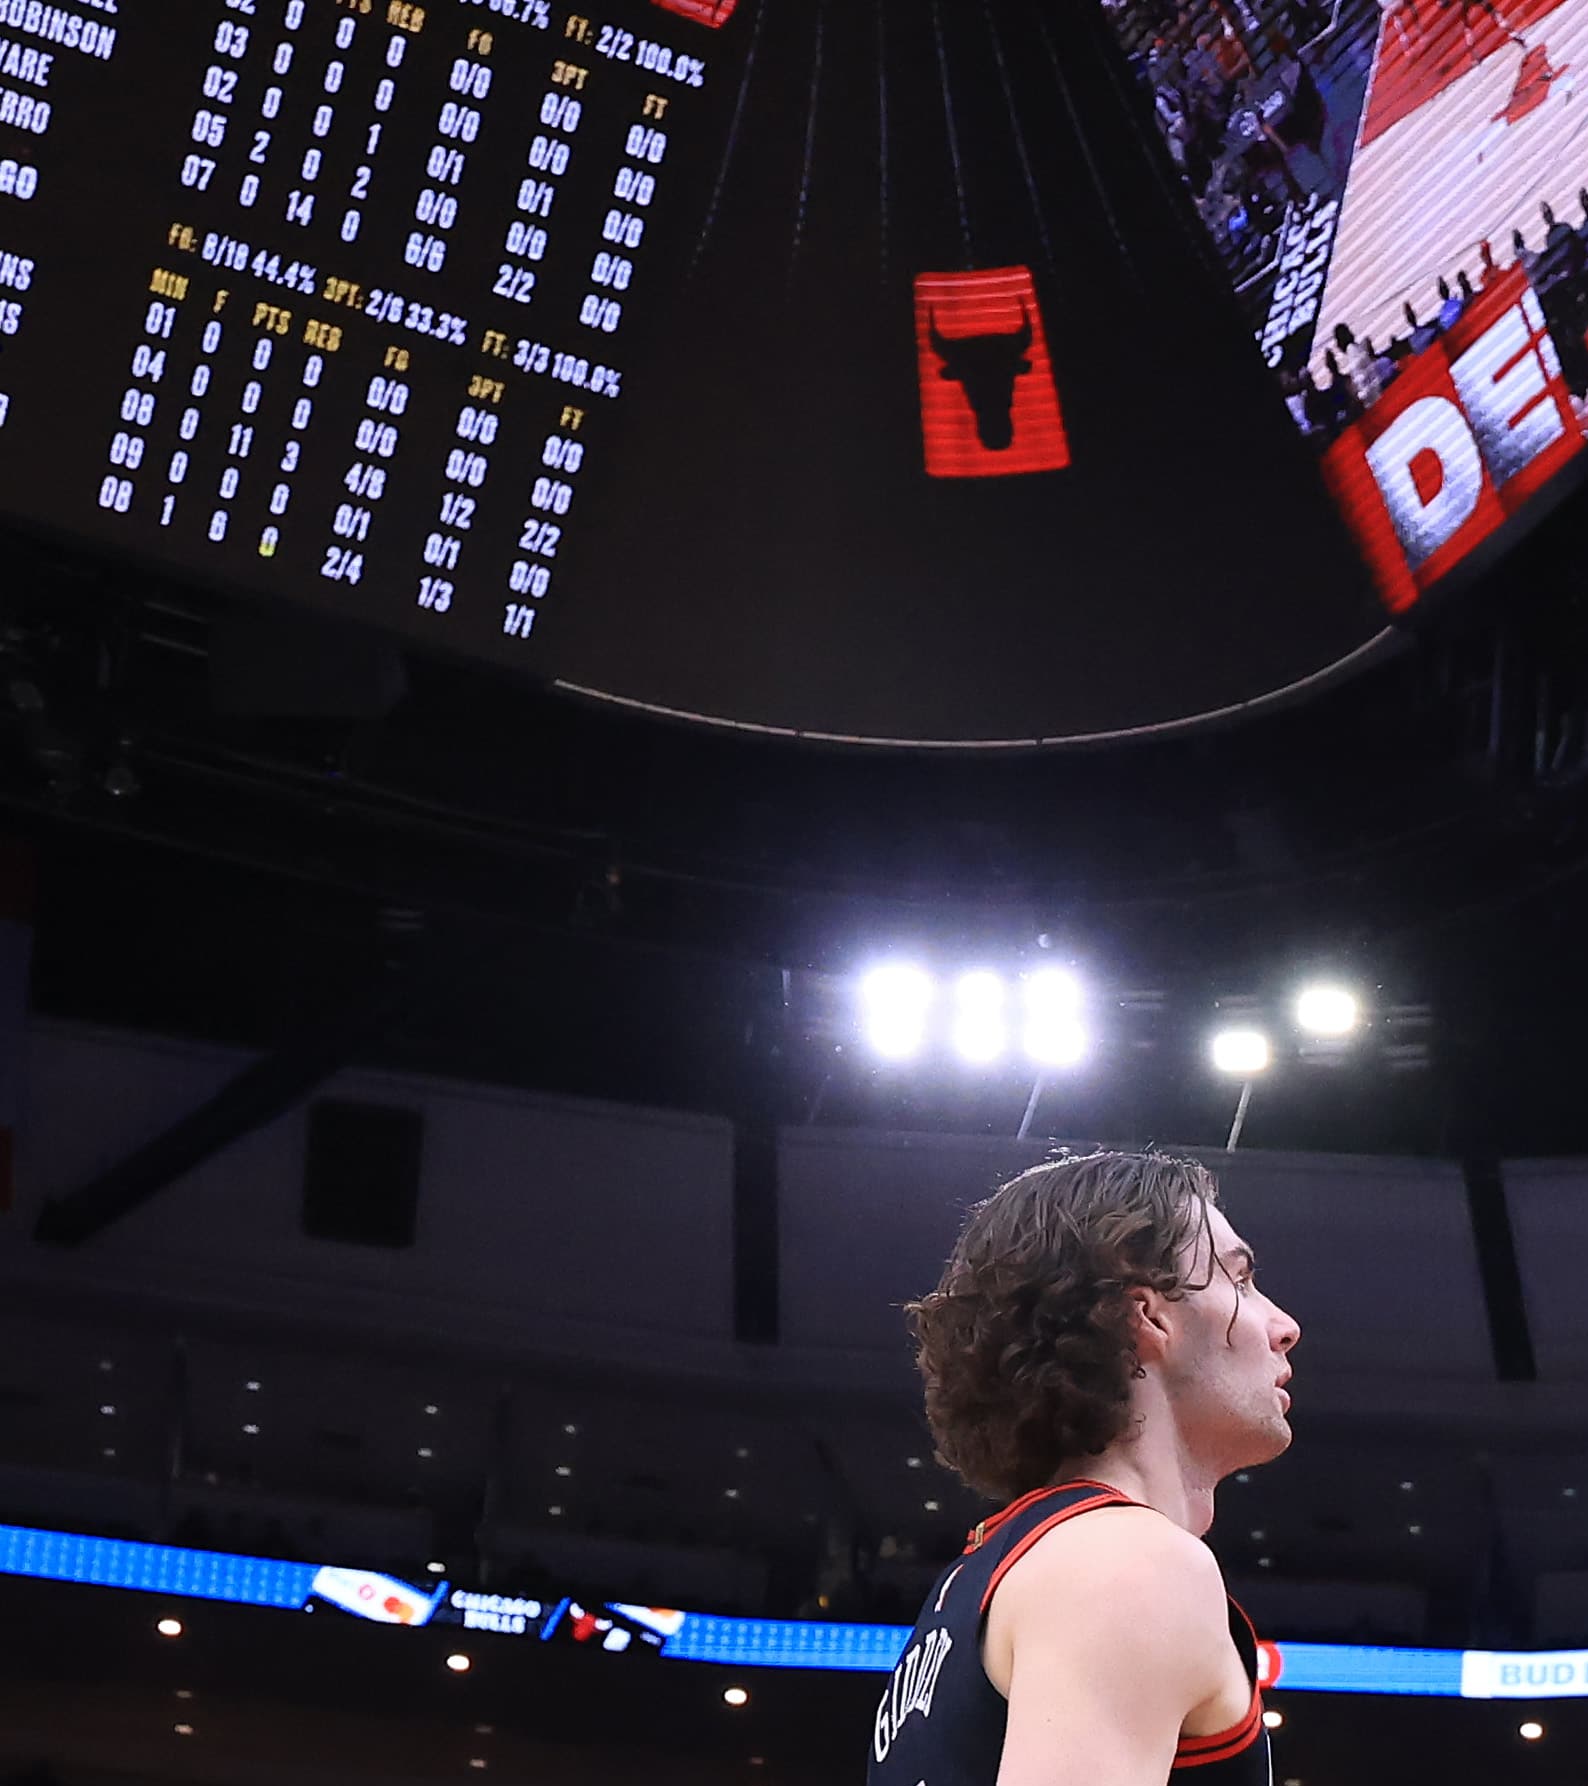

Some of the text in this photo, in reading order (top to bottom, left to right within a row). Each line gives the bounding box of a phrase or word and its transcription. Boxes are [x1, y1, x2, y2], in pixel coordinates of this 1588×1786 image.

[0, 0, 644, 249] OBINSON 02 0 0 1 0/1 0/1 0/0
[214, 20, 656, 206] 03 0 0 0 0/0 0/0 0/0
[335, 17, 356, 49] 0
[386, 35, 407, 68] 0
[449, 58, 493, 100] 0/0
[539, 92, 582, 133] 0/0
[625, 124, 667, 164] 0/0
[596, 25, 634, 60] 2/2
[635, 40, 705, 88] 100.0%
[0, 86, 622, 333] RRO 07 0 14 0 6/6 2/2 0/0
[191, 109, 228, 148] 05
[249, 130, 271, 164] 2
[301, 148, 322, 181] 0
[350, 165, 372, 200] 2
[415, 188, 458, 229] 0/0
[505, 221, 548, 261] 0/0
[590, 251, 633, 291] 0/0
[202, 232, 250, 272] 8/18
[251, 249, 317, 295] 44.4%
[404, 302, 468, 346] 33.3%
[513, 339, 550, 373] 3/3
[252, 302, 292, 335] PTS
[131, 344, 573, 515] 04 0 0 0 0/0 0/0 0/0
[145, 301, 584, 474] 01 0 0 0 0/0 0/0 0/0
[98, 475, 134, 513] 08
[160, 494, 175, 526] 1
[320, 546, 364, 585] 2/4
[417, 575, 454, 613] 1/3
[503, 603, 536, 639] 1/1
[109, 431, 551, 598] 09 0 0 0 0/1 0/1 0/0
[120, 388, 156, 427] 08
[179, 407, 200, 441] 0
[228, 423, 254, 458] 11
[280, 440, 301, 473] 3
[439, 492, 476, 530] 1/2
[518, 518, 561, 558] 2/2
[1500, 1661, 1575, 1687] BUD
